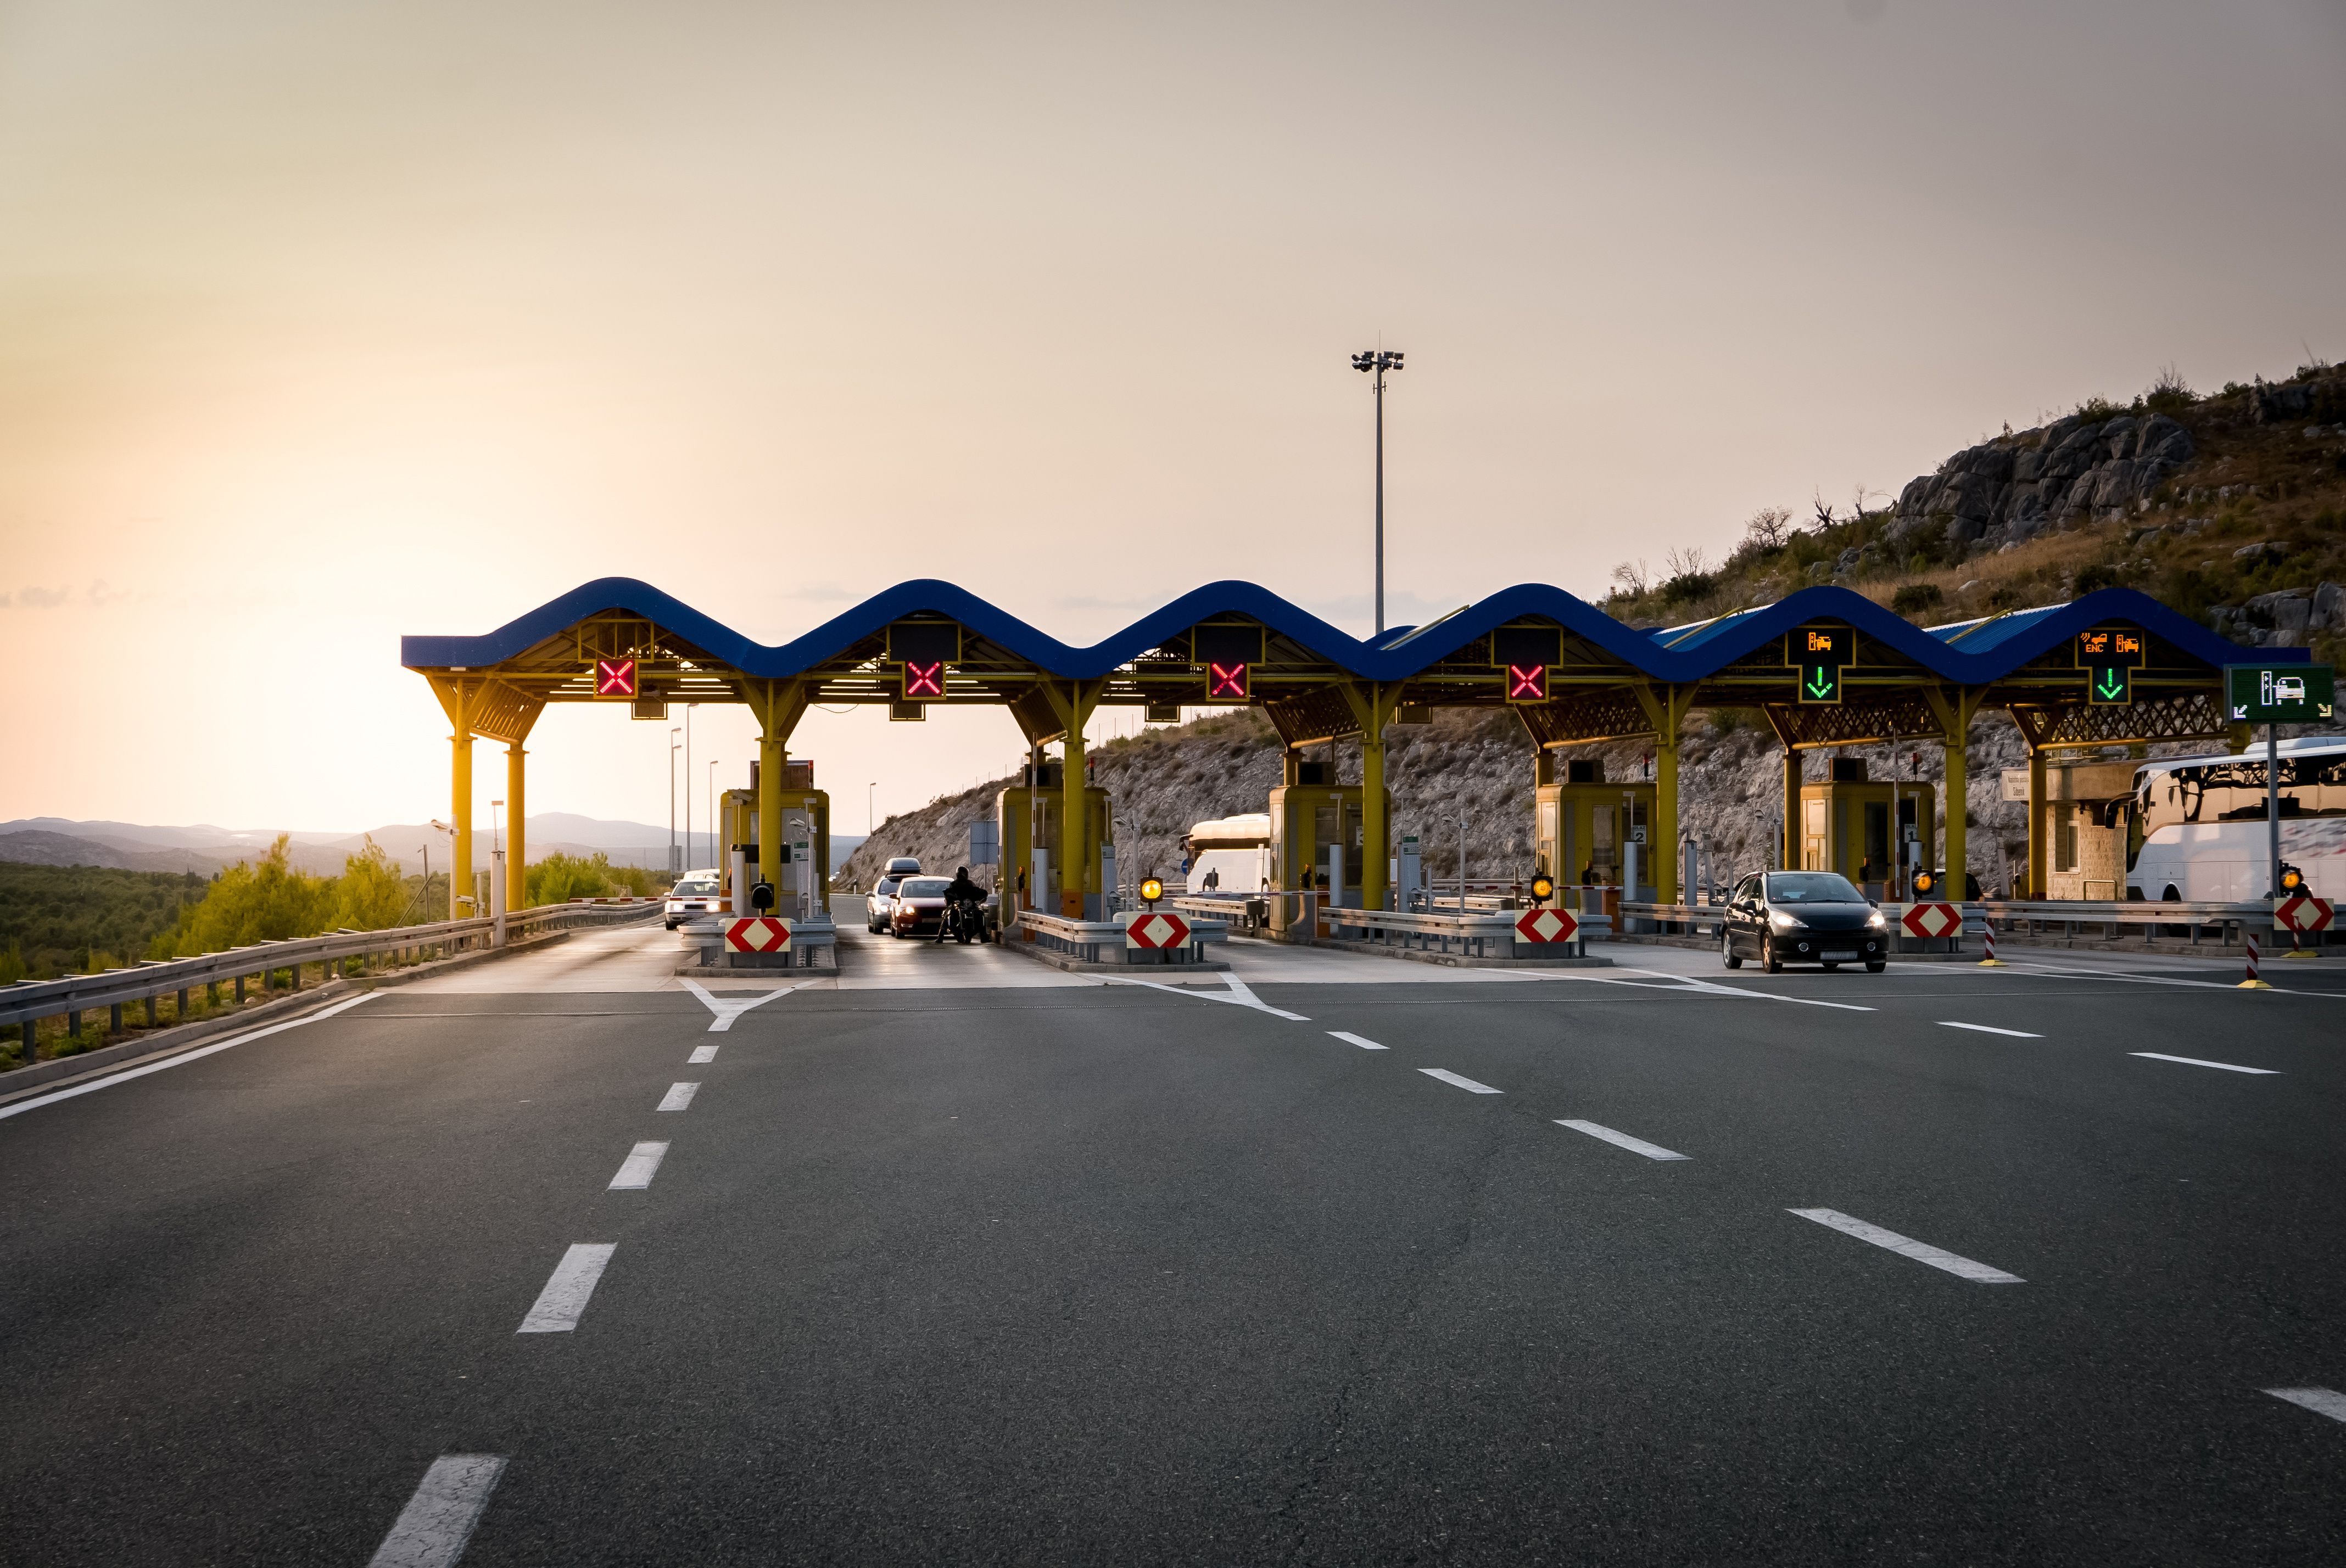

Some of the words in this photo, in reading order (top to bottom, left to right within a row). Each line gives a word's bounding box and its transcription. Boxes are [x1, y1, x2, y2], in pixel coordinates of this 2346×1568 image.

[2086, 644, 2104, 652] ENC
[1635, 832, 1644, 842] 2
[1908, 831, 1913, 840] 1
